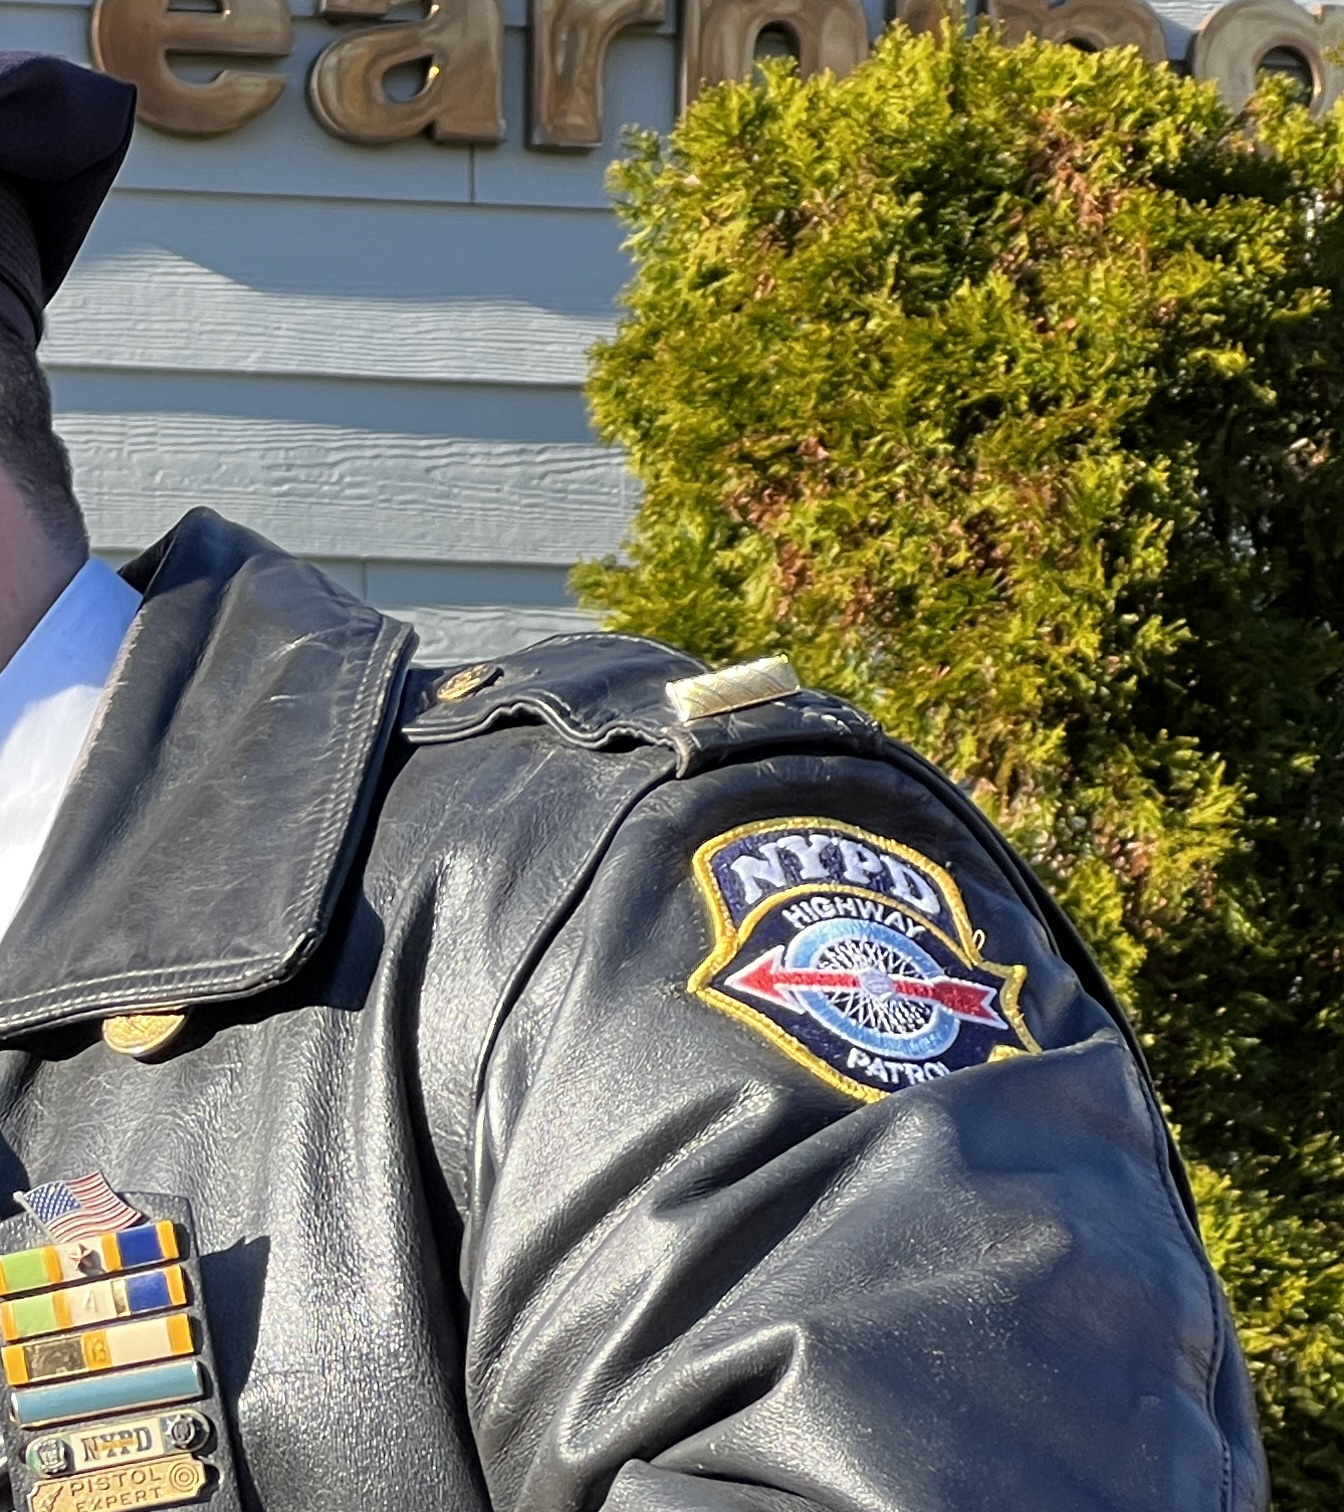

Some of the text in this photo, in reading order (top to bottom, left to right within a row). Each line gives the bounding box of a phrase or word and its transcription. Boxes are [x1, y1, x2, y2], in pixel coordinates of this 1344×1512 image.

[730, 834, 941, 916] NYPD
[782, 896, 927, 938] HIGHWAY
[80, 1427, 153, 1462] NYPD
[70, 1466, 162, 1496] PISTOL
[75, 1487, 162, 1512] EXPERT
